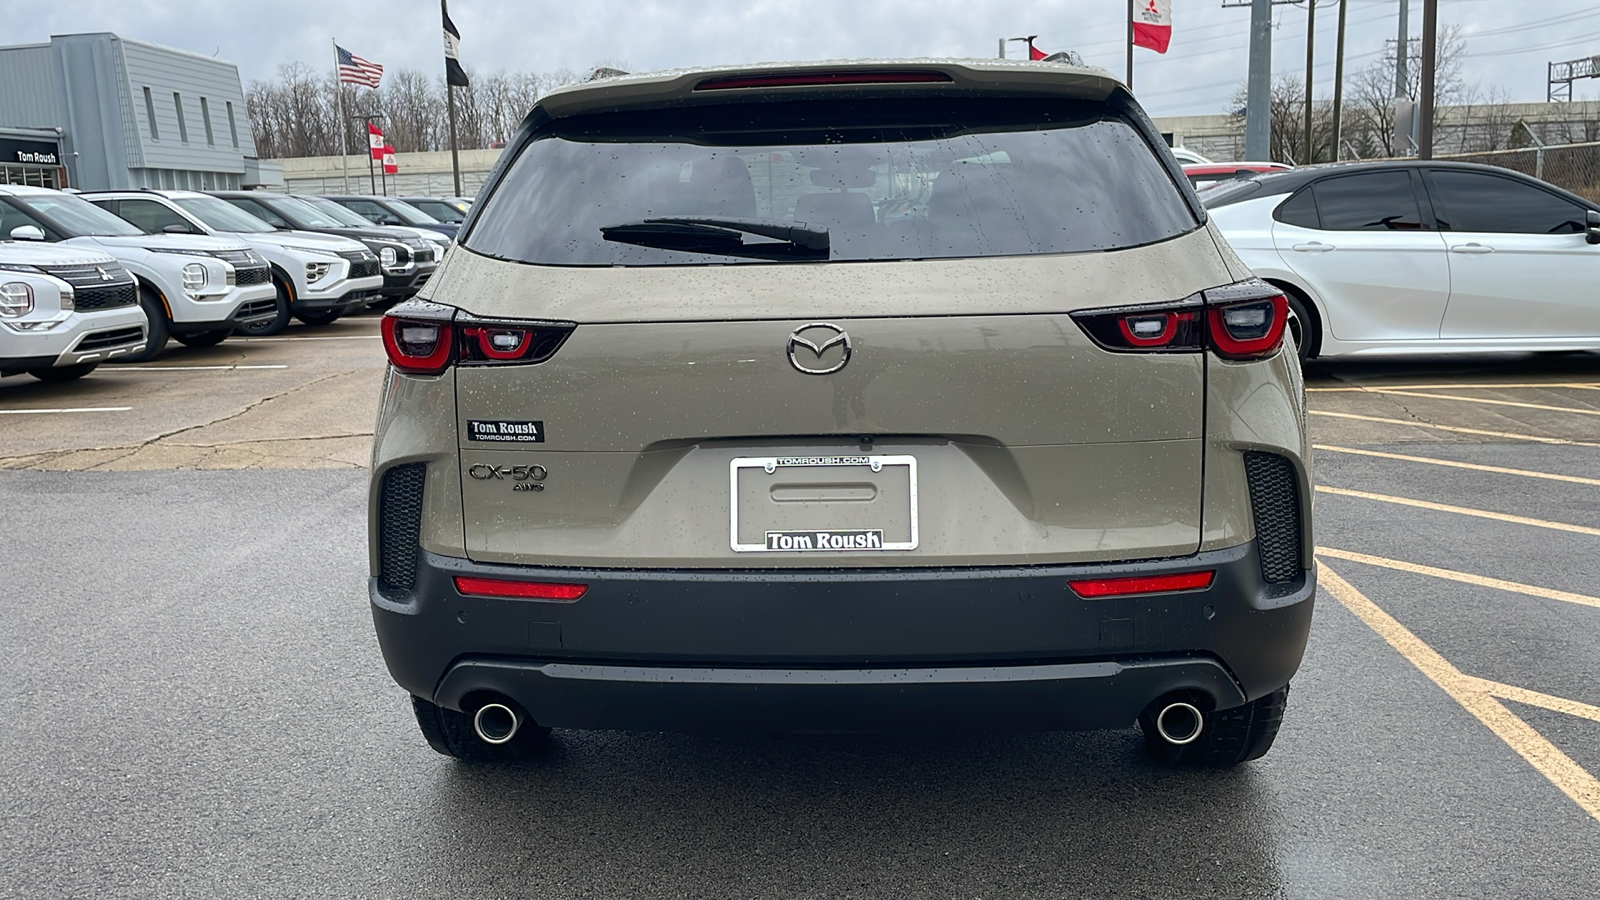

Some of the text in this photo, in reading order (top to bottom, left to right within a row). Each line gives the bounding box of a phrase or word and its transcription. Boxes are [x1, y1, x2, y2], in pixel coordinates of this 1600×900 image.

[17, 151, 56, 163] Tom Roush
[472, 421, 538, 434] Tom Roush
[778, 457, 868, 465] TOMROUSH.COM
[469, 463, 548, 481] CX-50
[513, 482, 545, 492] AWD
[768, 531, 881, 549] Tom Roush
